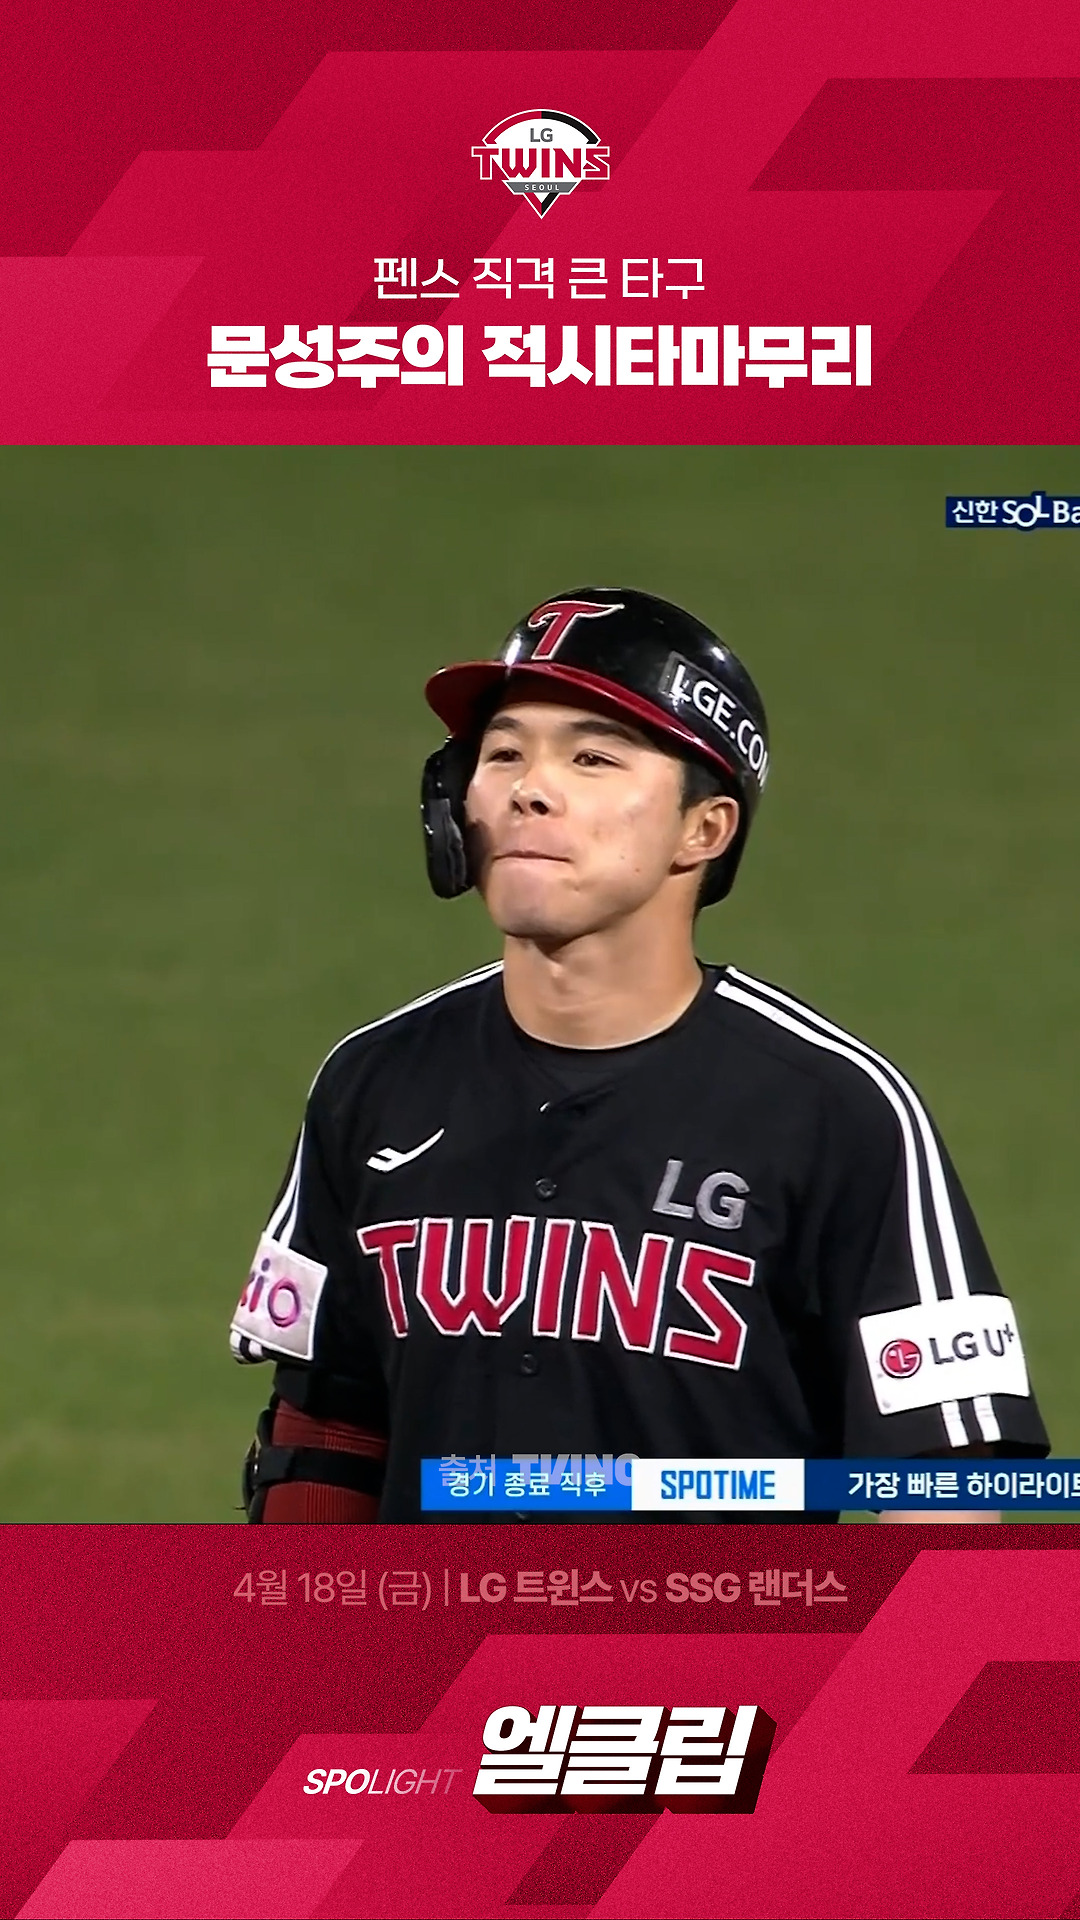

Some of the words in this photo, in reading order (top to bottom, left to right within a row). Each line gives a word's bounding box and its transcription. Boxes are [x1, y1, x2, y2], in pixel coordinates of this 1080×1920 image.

[527, 600, 625, 660] T
[652, 1159, 751, 1230] LG
[356, 1214, 756, 1371] TWINS
[928, 1331, 979, 1365] LG
